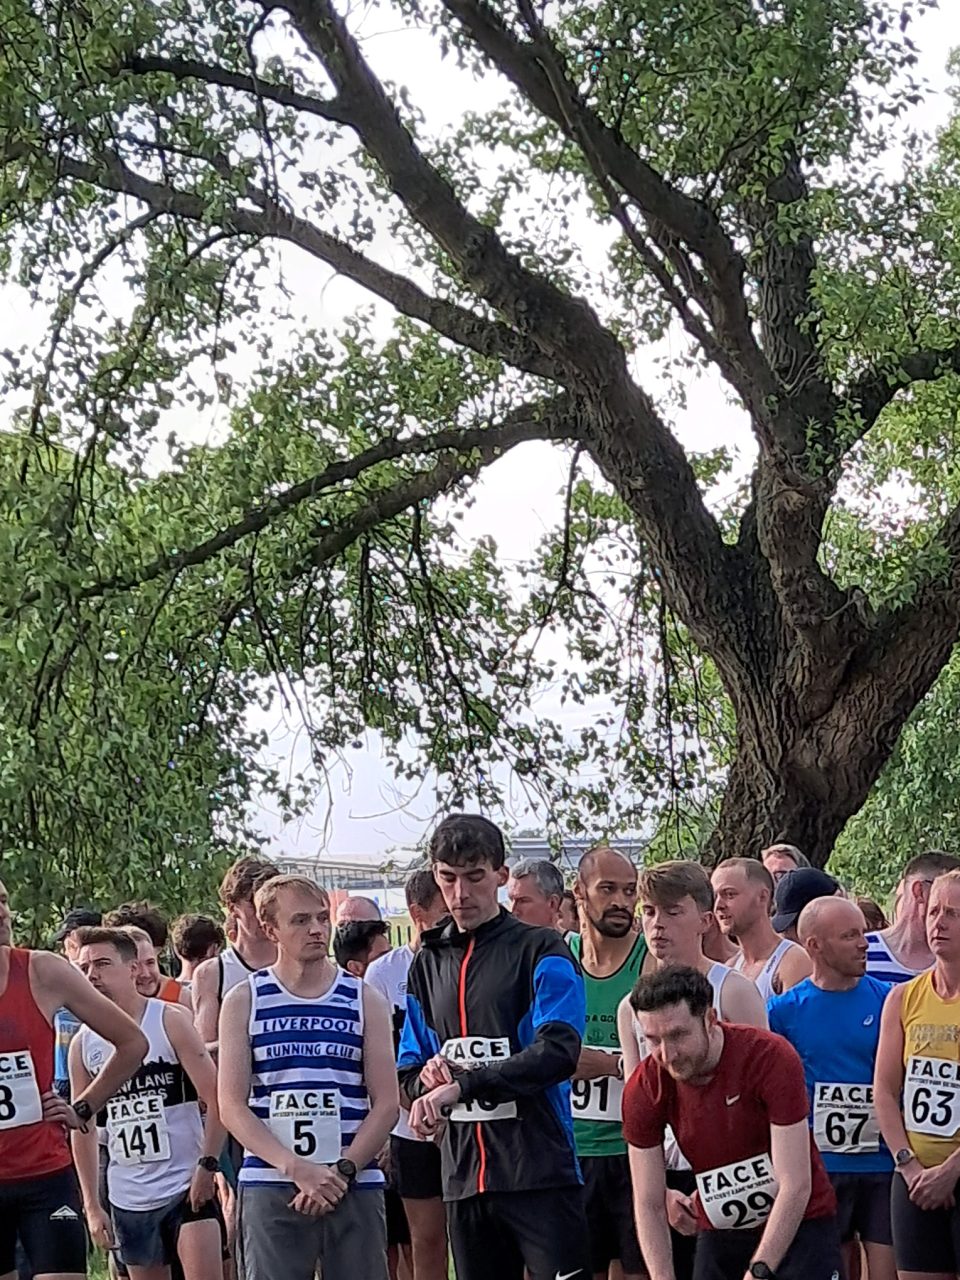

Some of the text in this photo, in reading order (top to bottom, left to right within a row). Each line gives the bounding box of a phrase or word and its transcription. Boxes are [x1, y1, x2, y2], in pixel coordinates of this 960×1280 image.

[263, 1018, 356, 1033] LIVERPOOL
[266, 1043, 355, 1058] RUNNING CLUB
[136, 1072, 175, 1090] LANE
[572, 1075, 609, 1112] 91
[912, 1087, 956, 1127] 63
[117, 1122, 161, 1159] 141
[293, 1119, 317, 1157] 5
[825, 1111, 870, 1147] 67
[721, 1191, 776, 1228] 29
